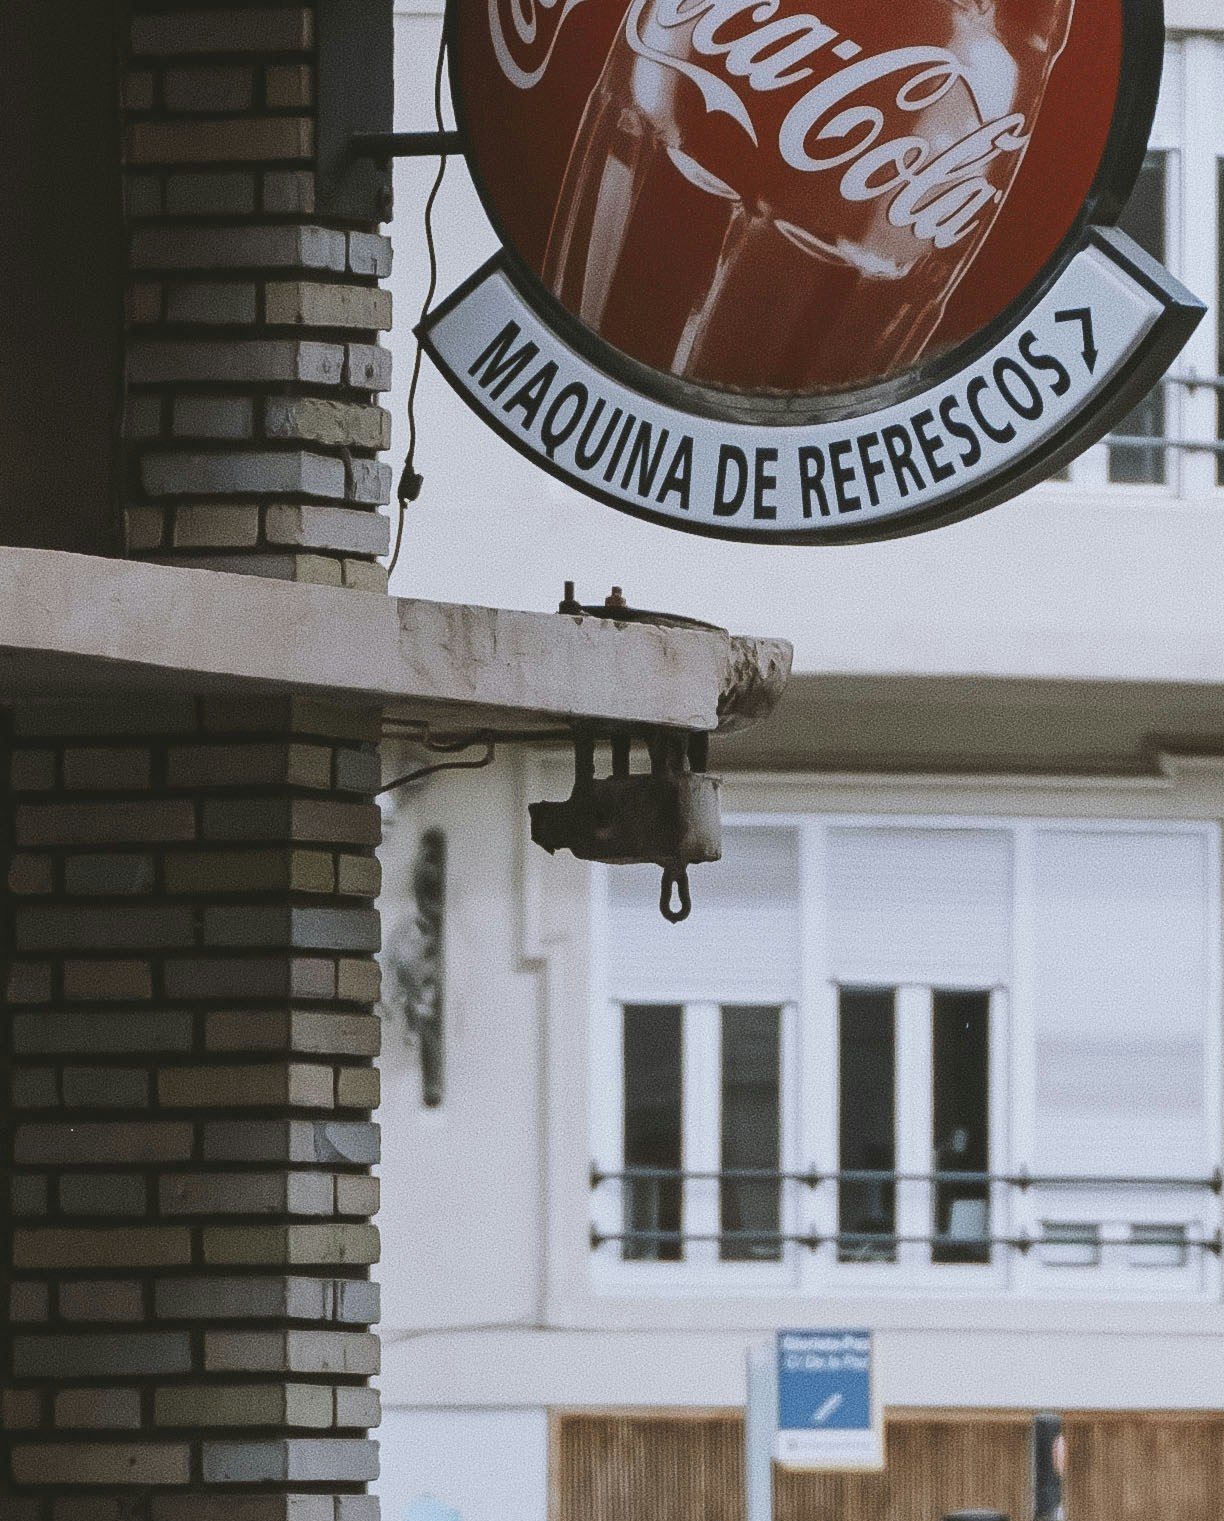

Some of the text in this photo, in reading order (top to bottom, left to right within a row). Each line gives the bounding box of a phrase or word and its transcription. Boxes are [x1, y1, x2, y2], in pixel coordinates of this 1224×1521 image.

[467, 319, 1071, 520] MAQUINA DE REFRESCOS
